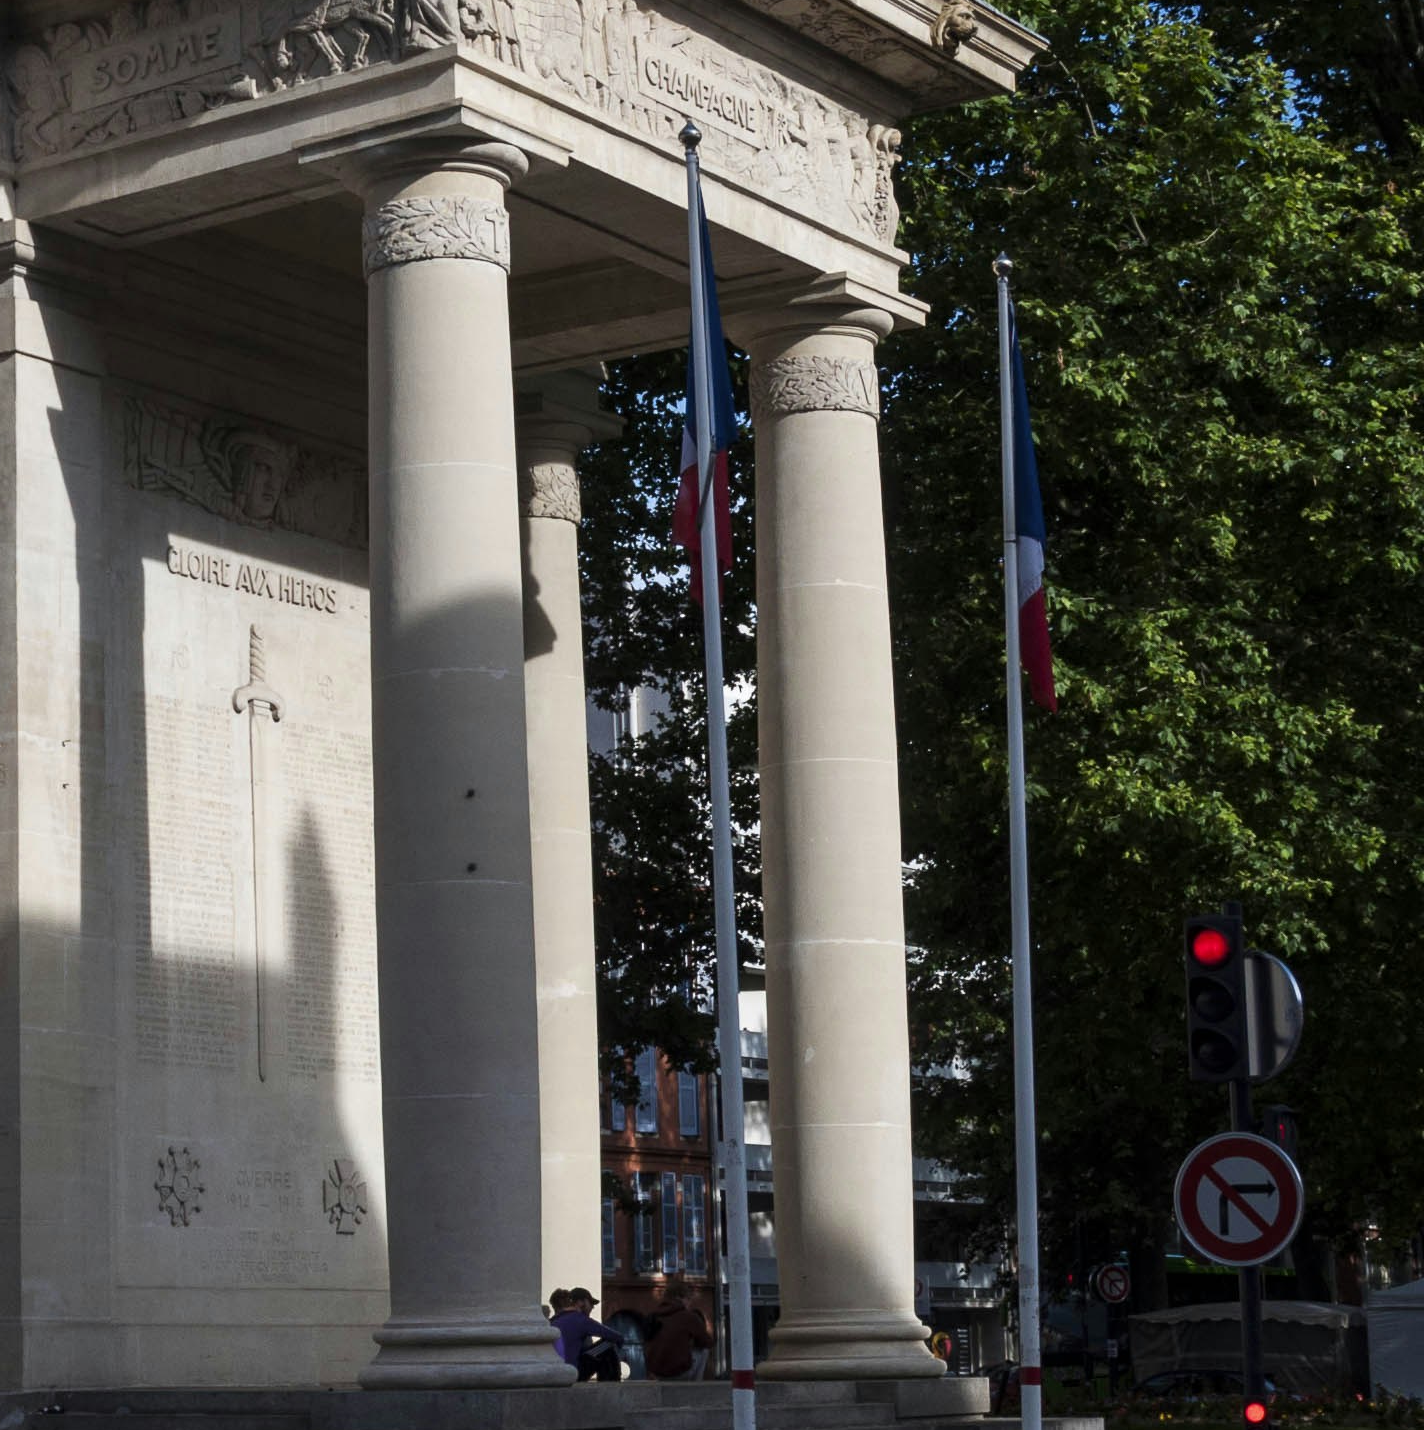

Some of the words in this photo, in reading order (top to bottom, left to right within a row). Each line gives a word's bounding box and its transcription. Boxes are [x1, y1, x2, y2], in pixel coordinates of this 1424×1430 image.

[91, 25, 221, 93] SOMME
[644, 56, 756, 133] CHAMPAGNE
[166, 545, 230, 588] GLOIRE
[279, 574, 337, 614] HEROS
